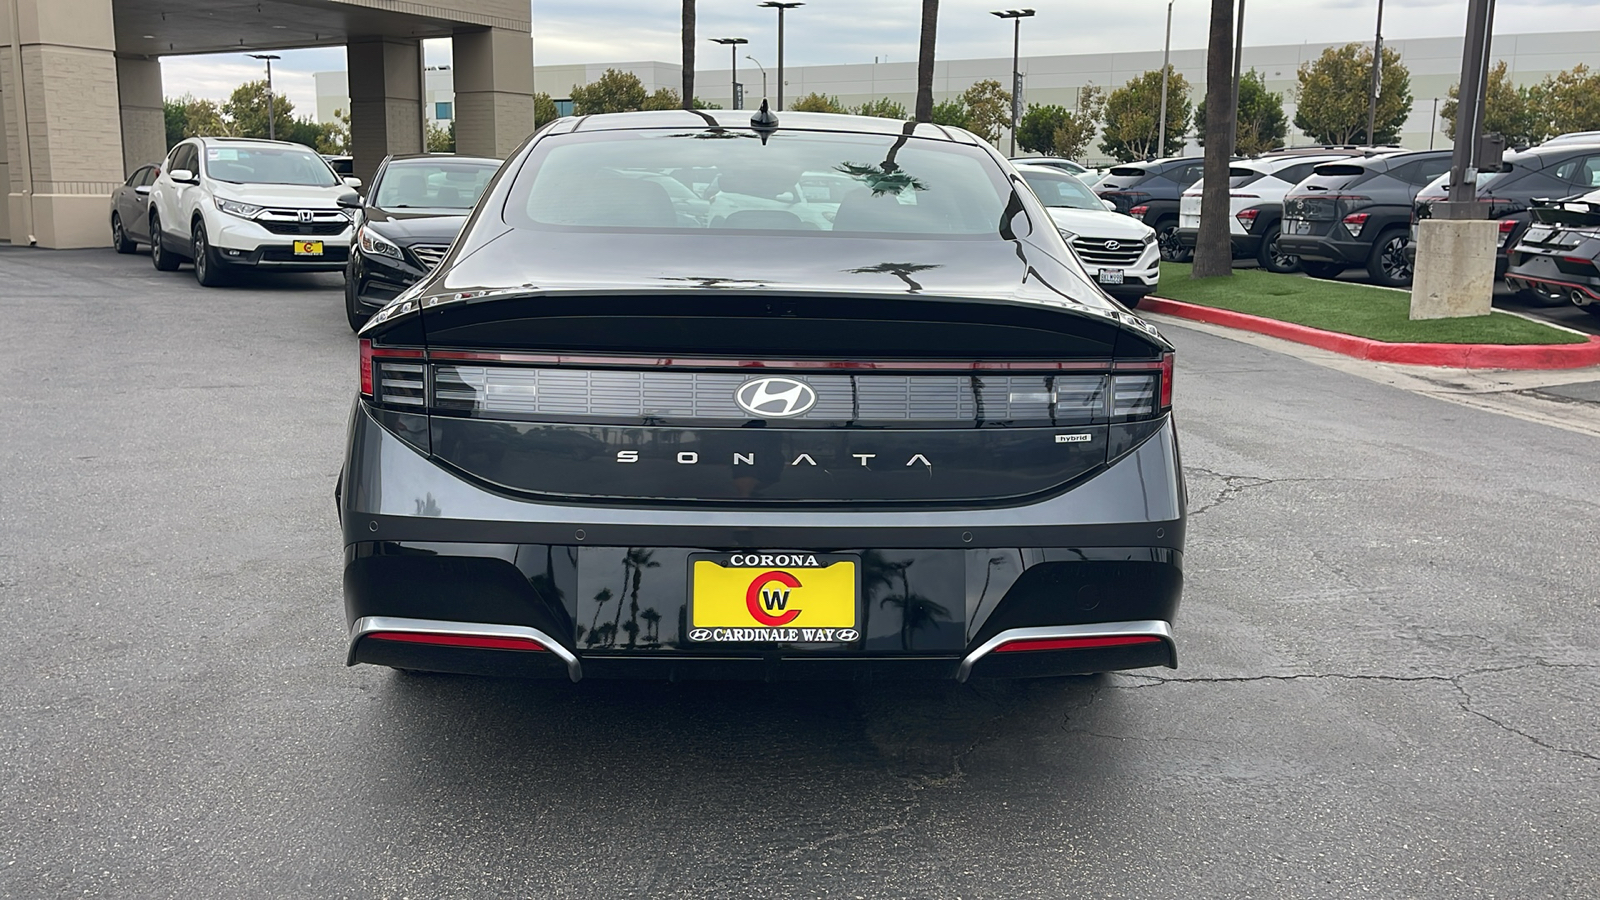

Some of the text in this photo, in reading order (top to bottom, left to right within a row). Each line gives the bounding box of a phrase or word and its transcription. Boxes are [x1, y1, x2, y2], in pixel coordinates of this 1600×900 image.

[616, 450, 932, 466] SONATA
[730, 554, 819, 567] CORONA
[713, 628, 836, 642] CARDINALE WAY
